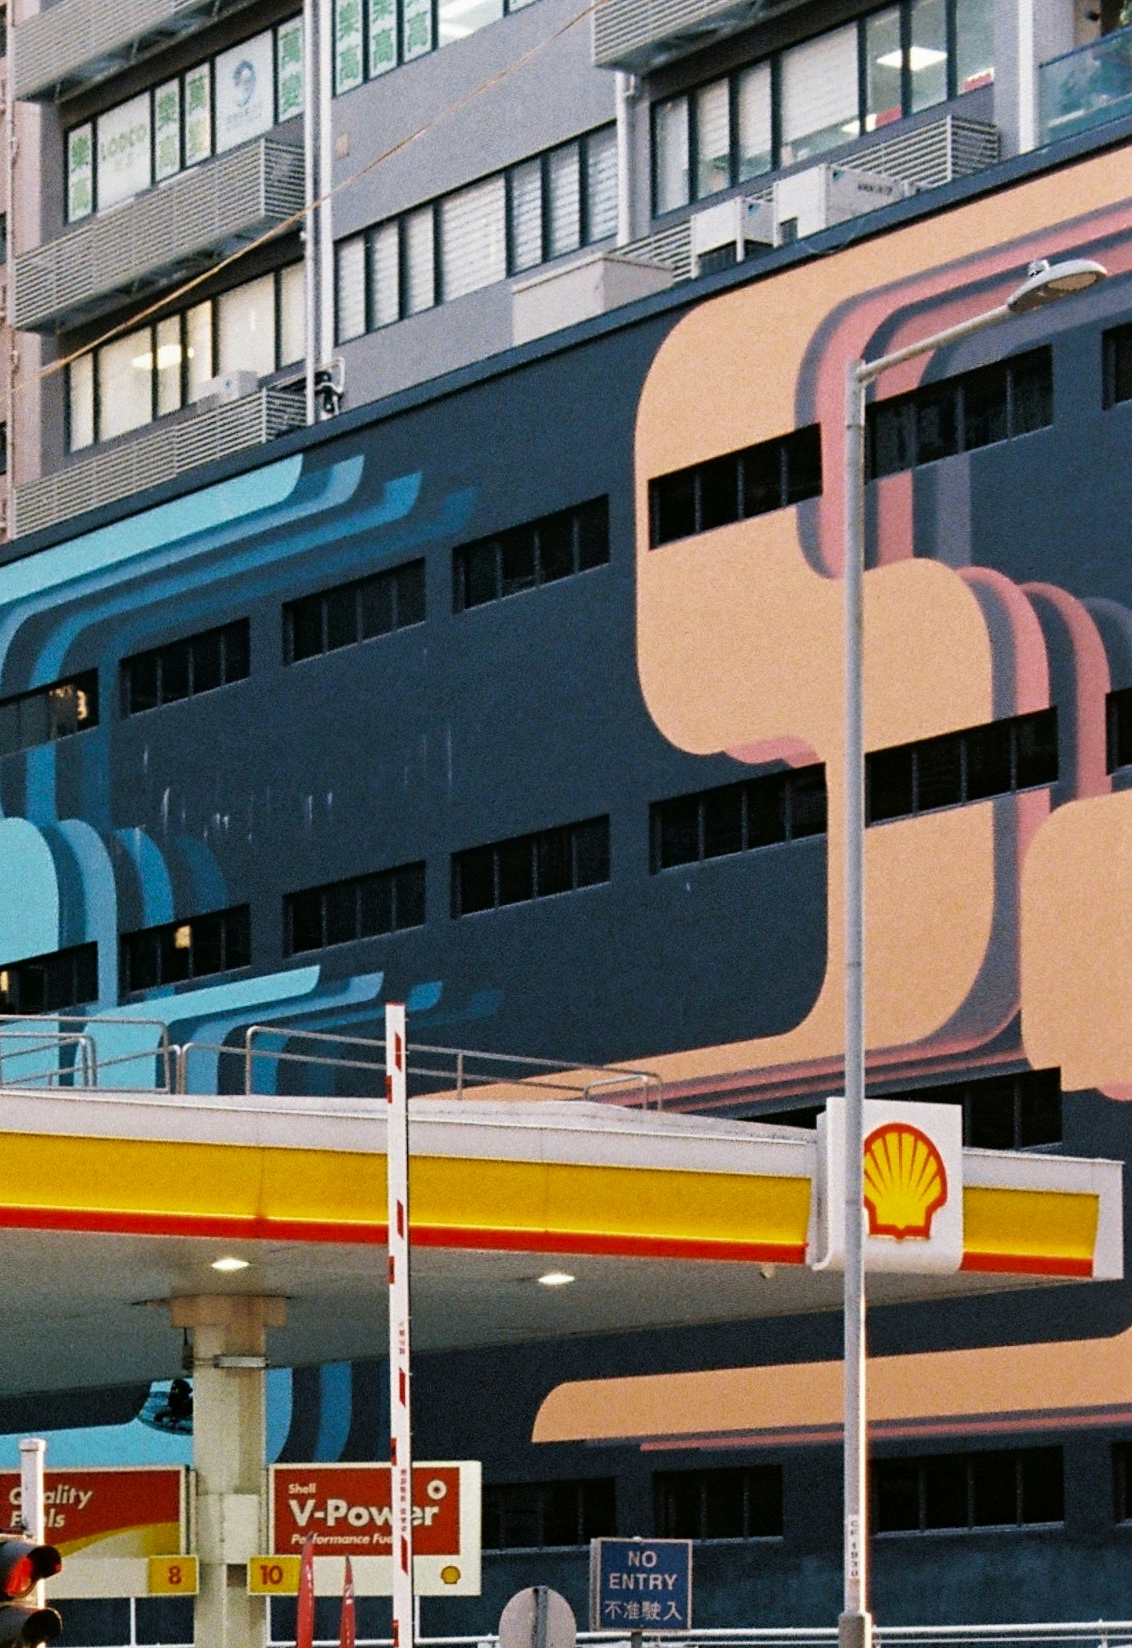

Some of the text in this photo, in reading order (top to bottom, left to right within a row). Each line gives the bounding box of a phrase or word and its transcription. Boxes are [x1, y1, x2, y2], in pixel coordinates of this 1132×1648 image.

[9, 1485, 93, 1509] Qality
[288, 1483, 317, 1495] Shell
[10, 1508, 66, 1528] Fls
[289, 1499, 439, 1527] V-Power
[291, 1532, 393, 1545] Peformance Fue
[628, 1551, 658, 1568] NO
[168, 1566, 182, 1585] 8
[260, 1566, 283, 1585] 10
[609, 1573, 677, 1591] ENTRY
[605, 1600, 682, 1621] 不准駛入
